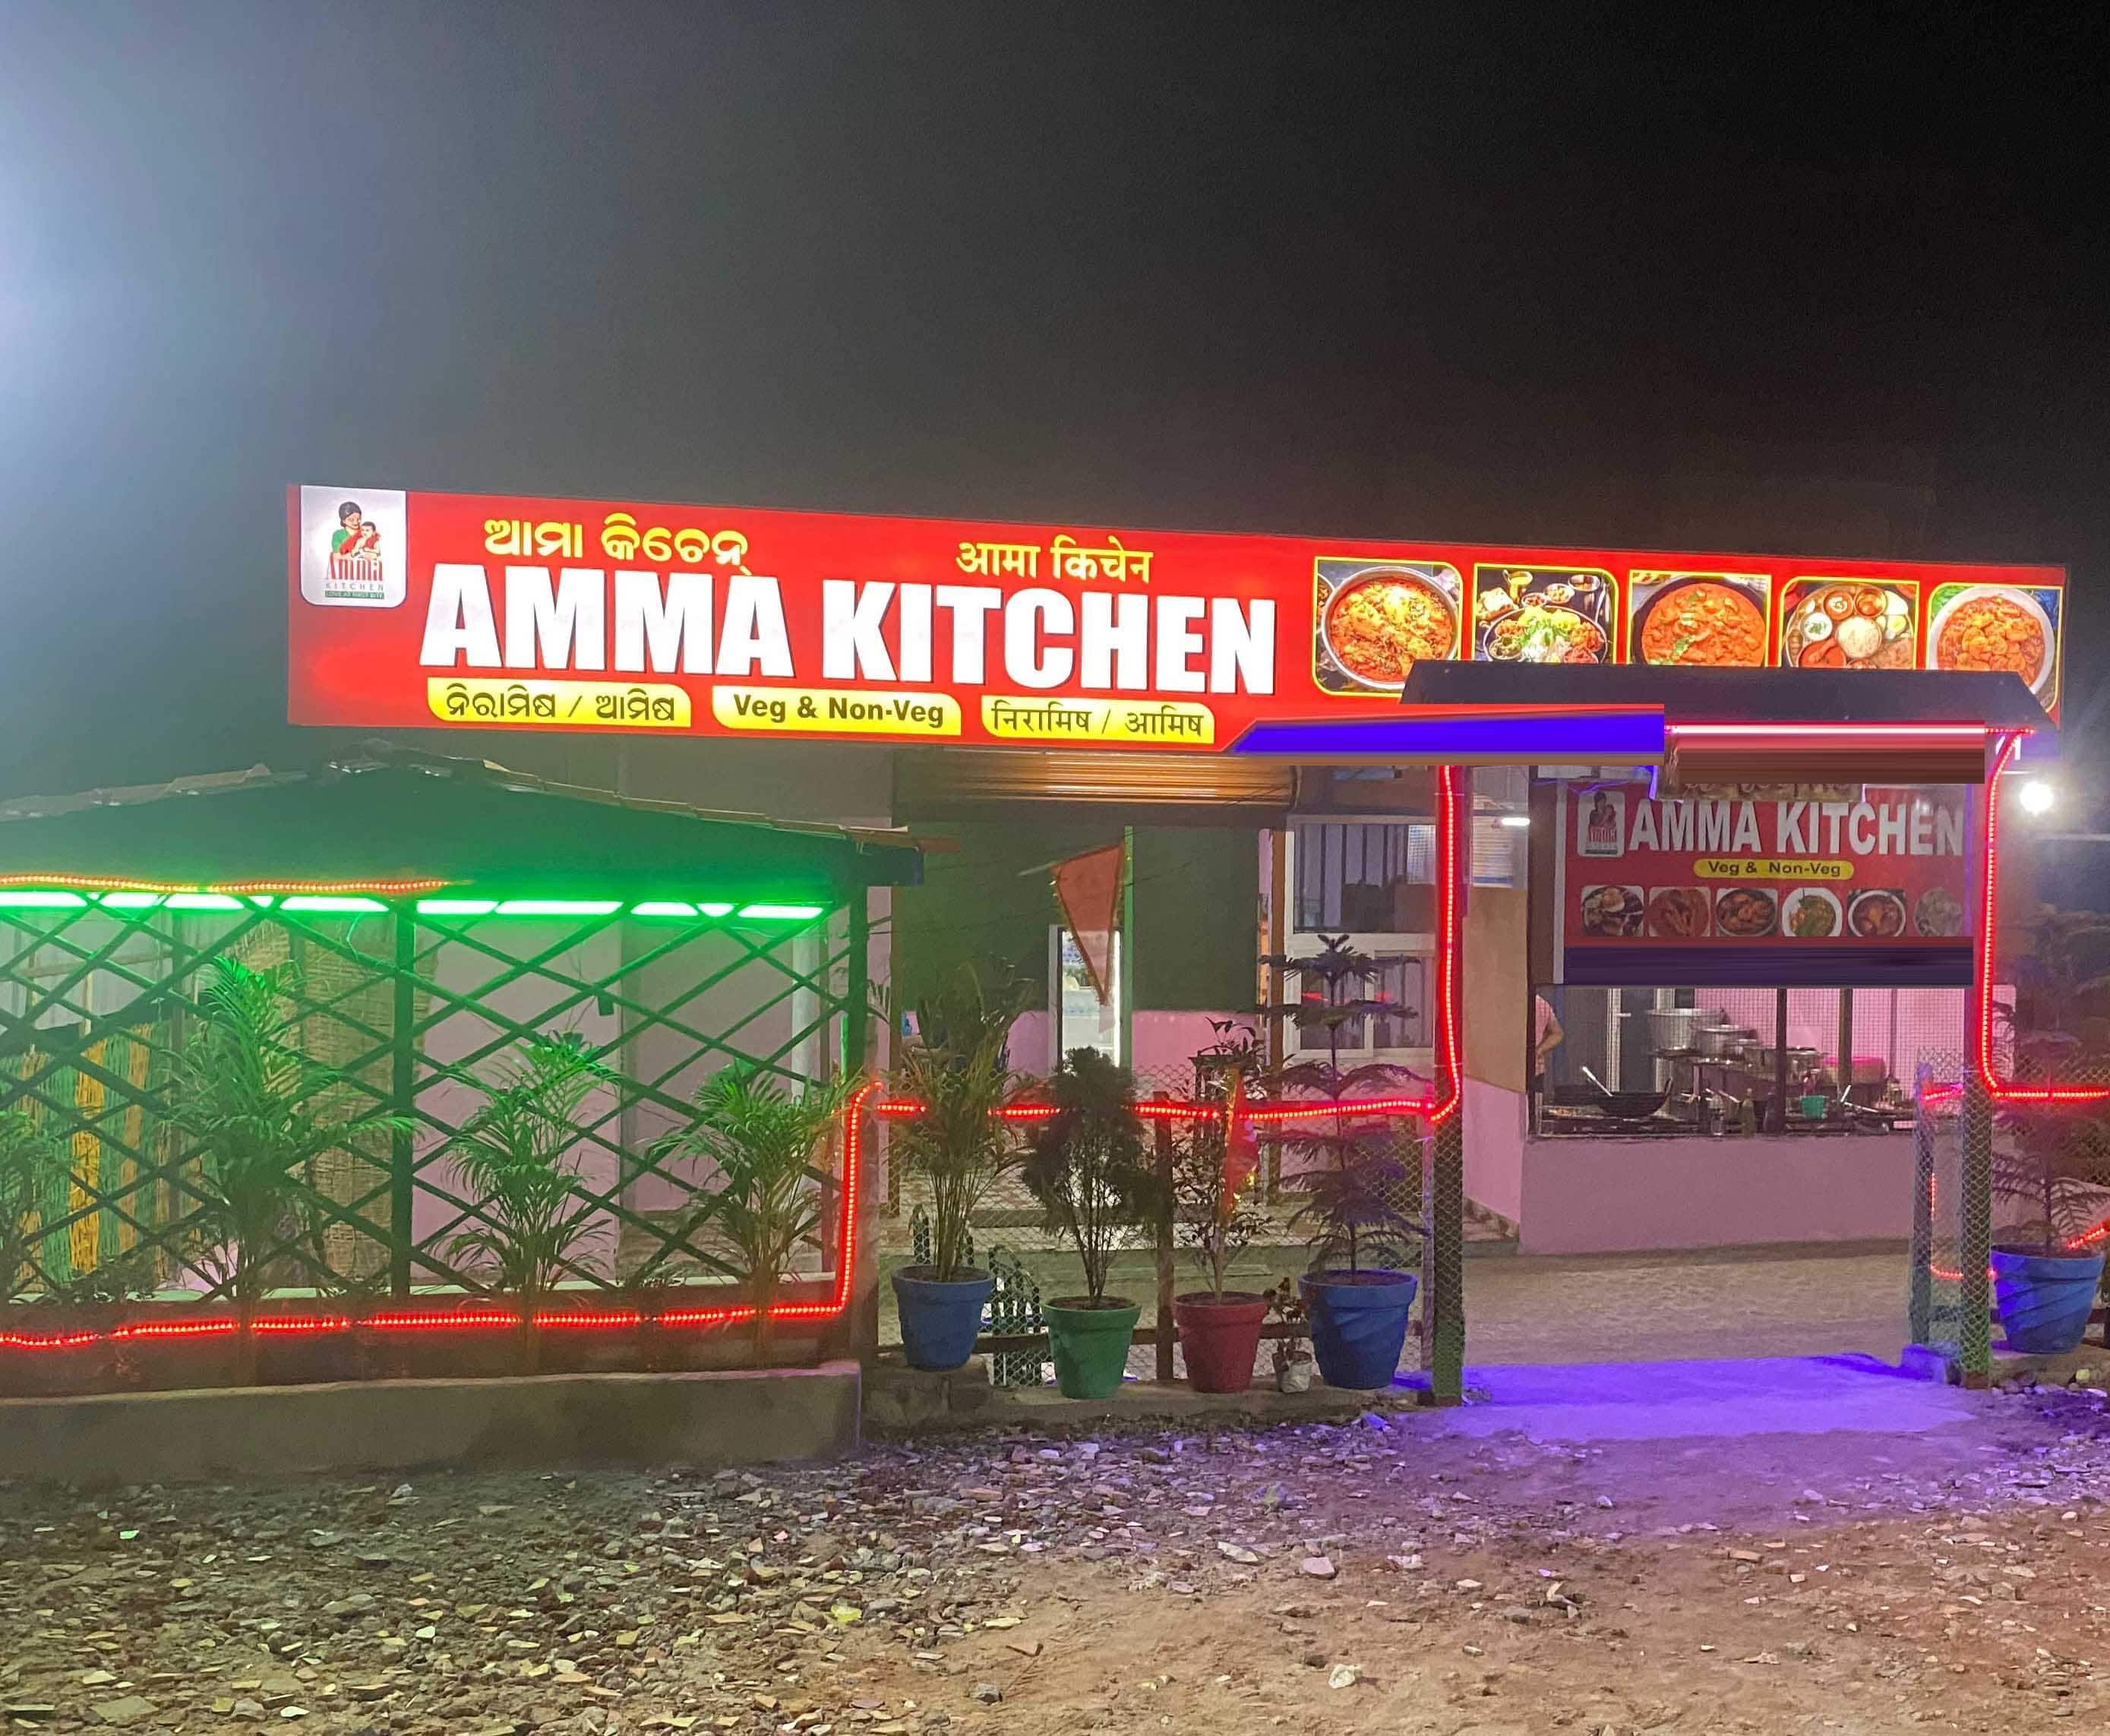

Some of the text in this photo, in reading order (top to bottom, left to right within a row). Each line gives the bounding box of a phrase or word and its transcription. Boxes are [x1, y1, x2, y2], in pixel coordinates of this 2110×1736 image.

[484, 513, 752, 576] ଆମା କିଚେନ୍
[956, 535, 1154, 583] आमा किचेन
[324, 552, 383, 581] Amma
[325, 582, 384, 591] KITCHEN
[419, 563, 1276, 695] AMMA KITCHEN
[446, 683, 556, 718] ନିରାମିଷ
[595, 688, 674, 721] ଆମିଷ
[734, 694, 943, 728] Veg & Non-Veg
[991, 699, 1092, 733] निरामिष
[1125, 705, 1204, 736] आमिष
[1628, 799, 1963, 856] AMMA KITCHEN
[1707, 861, 1840, 876] Veg & Non-Veg
